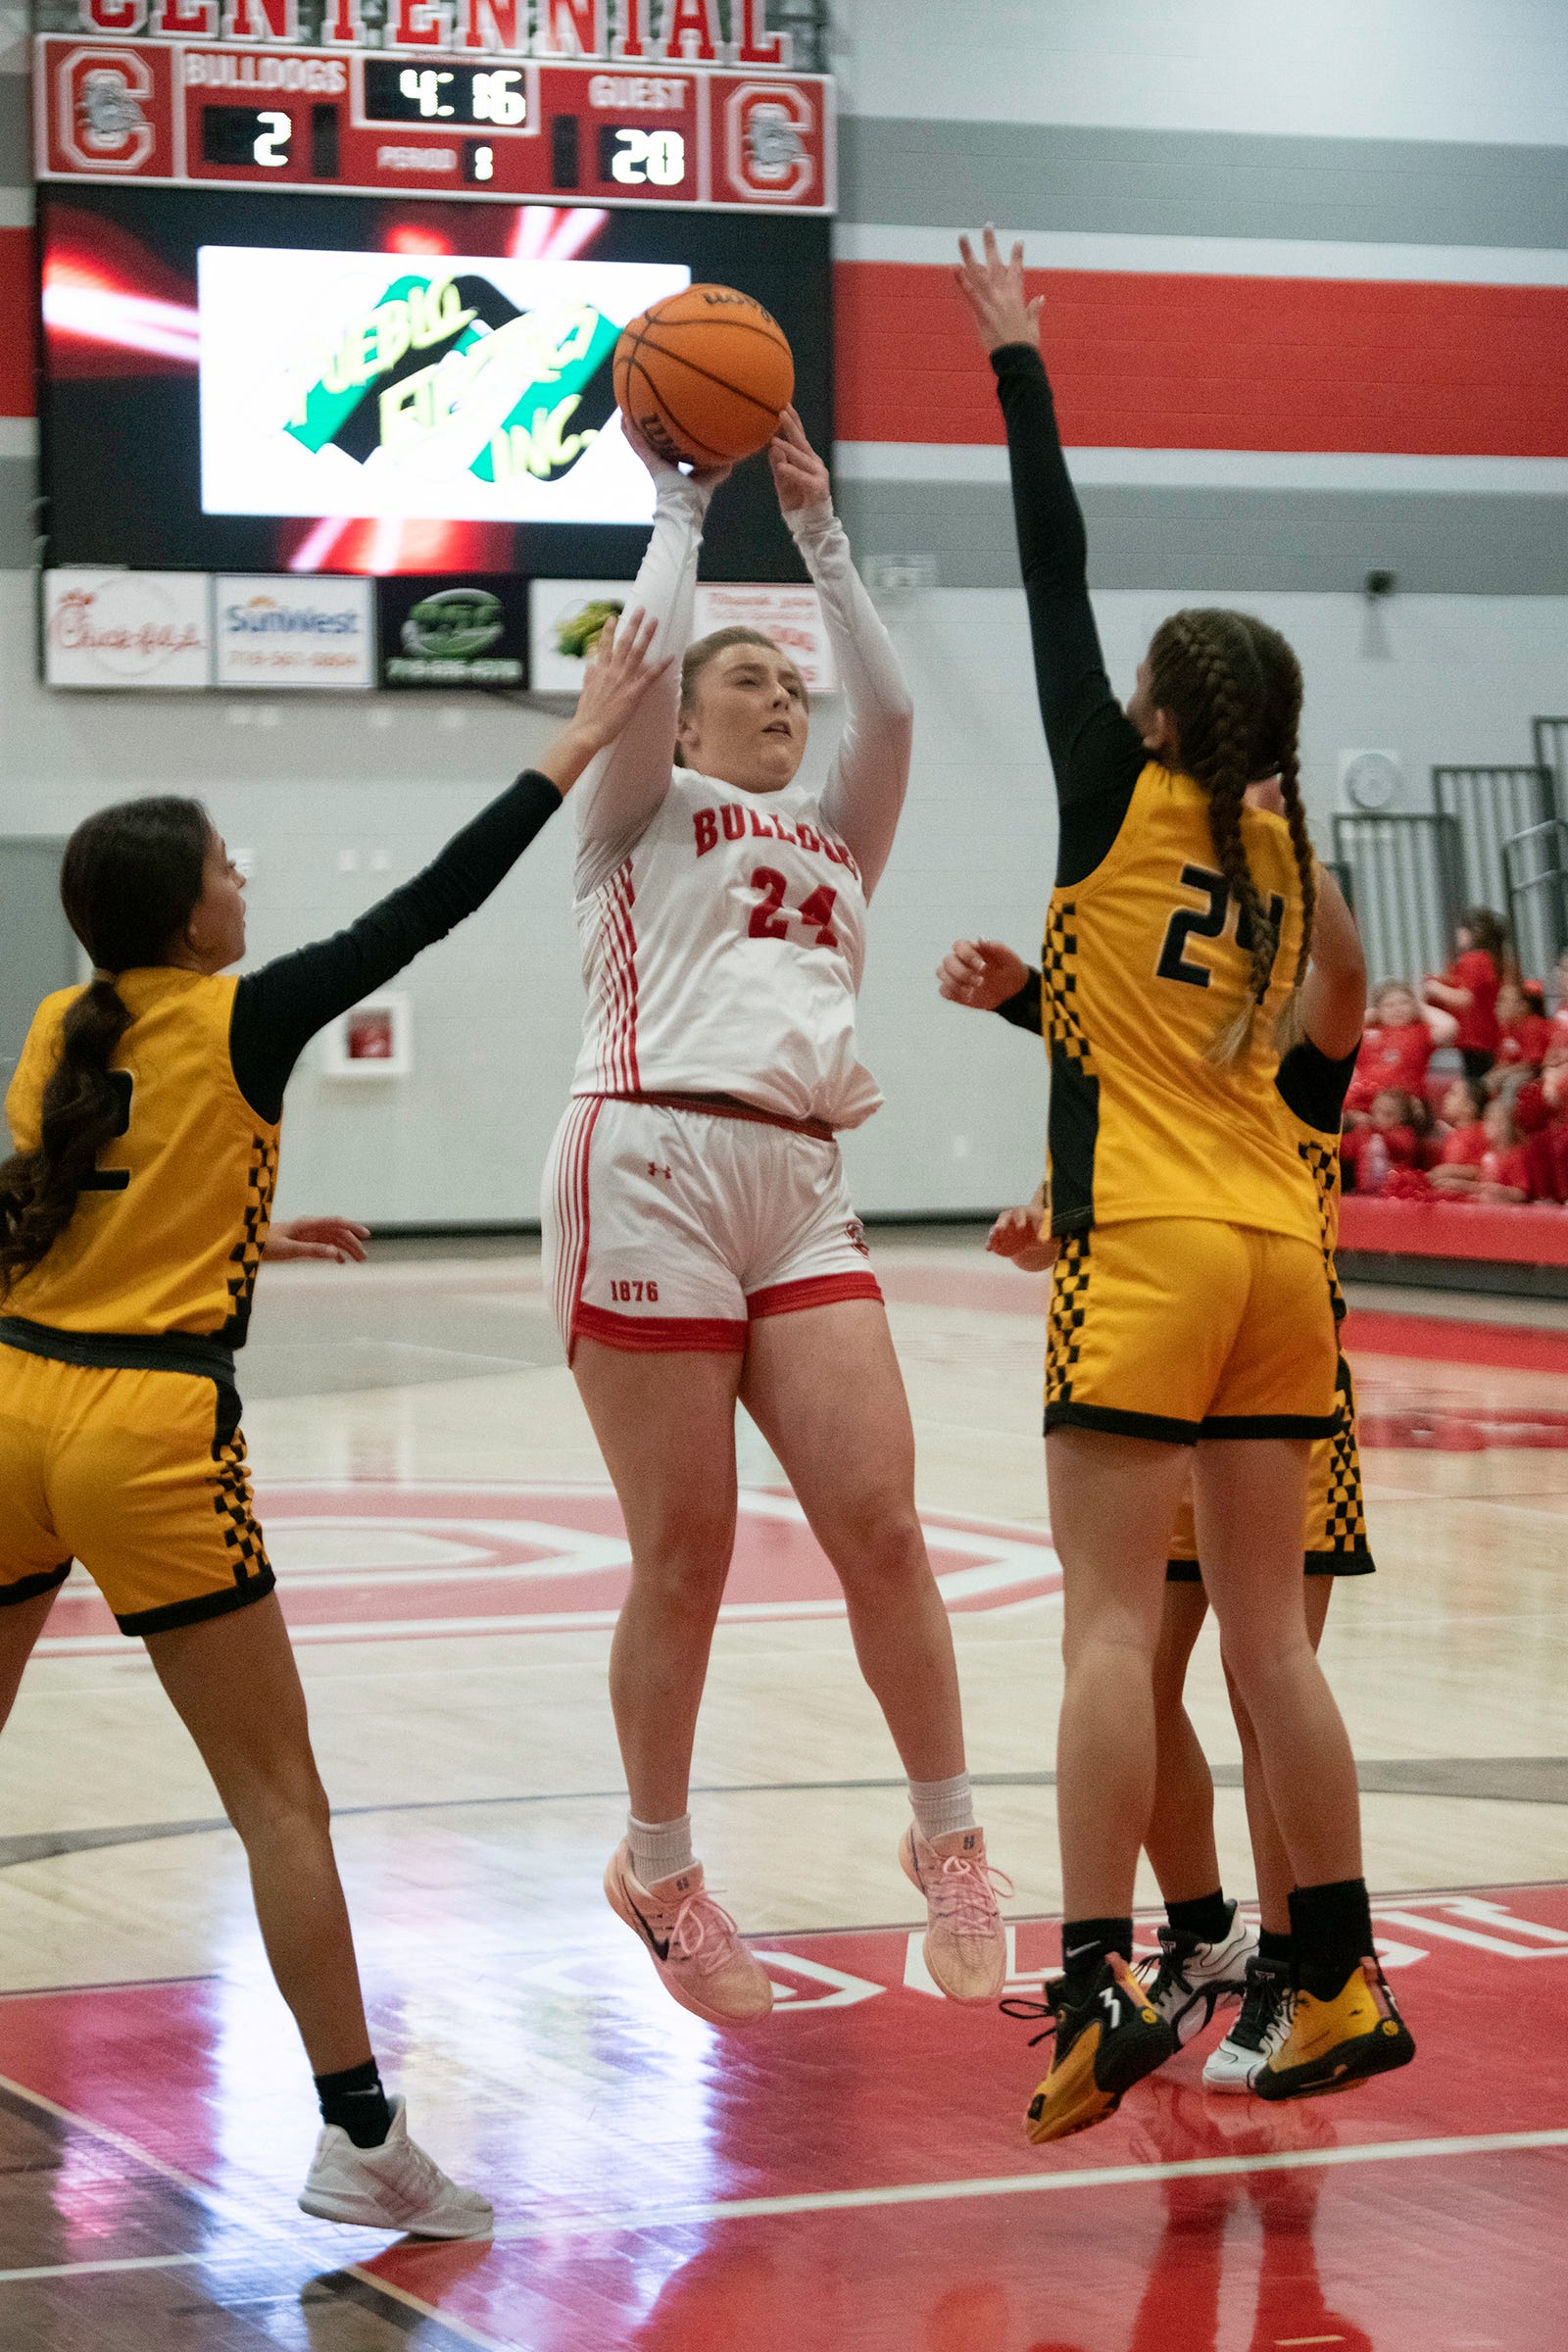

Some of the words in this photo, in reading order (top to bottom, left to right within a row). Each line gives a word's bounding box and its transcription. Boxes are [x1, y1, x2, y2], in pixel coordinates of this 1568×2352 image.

[185, 54, 348, 93] BULLDOGS
[590, 75, 688, 110] GUEST
[254, 111, 292, 167] 2
[612, 128, 685, 186] 20
[748, 866, 839, 948] 24
[610, 1280, 659, 1302] 1876
